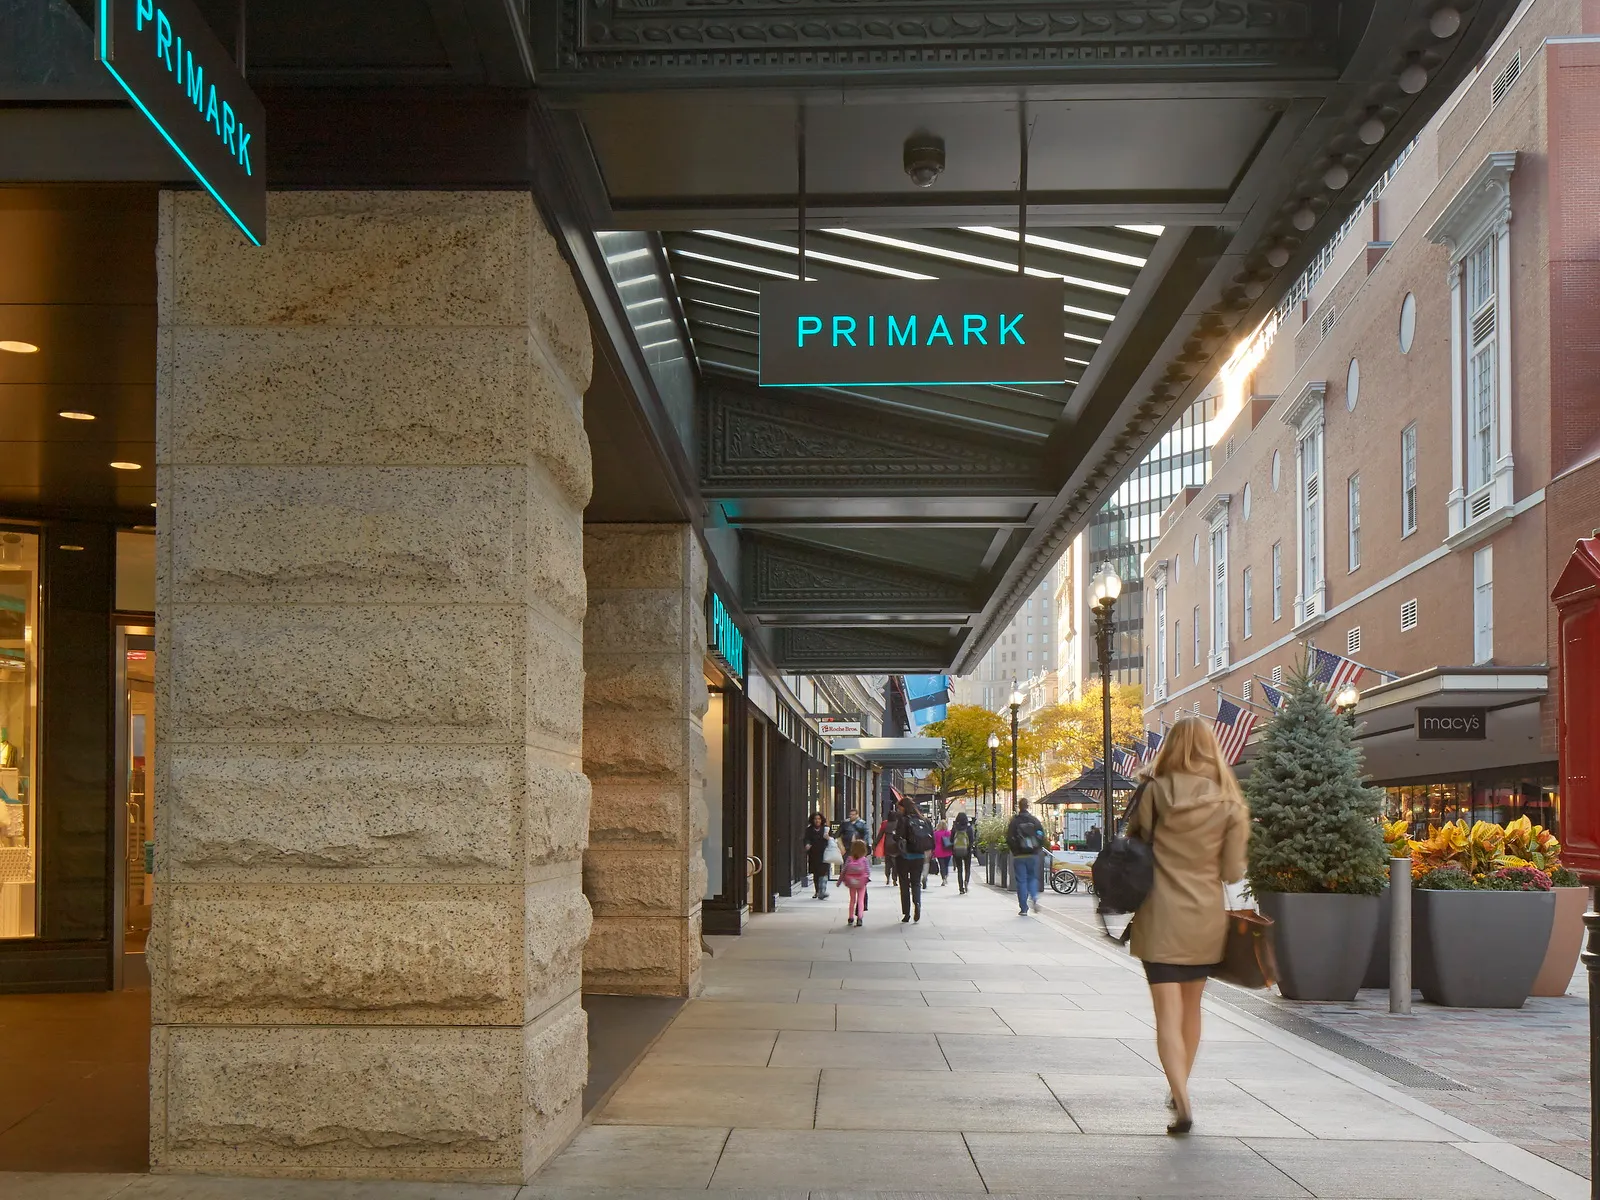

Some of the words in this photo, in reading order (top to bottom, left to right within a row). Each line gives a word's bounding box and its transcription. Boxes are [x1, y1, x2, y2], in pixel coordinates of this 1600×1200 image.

[797, 314, 1026, 348] PRIMARK
[713, 592, 743, 679] PRIMARK
[1424, 715, 1480, 733] macy's
